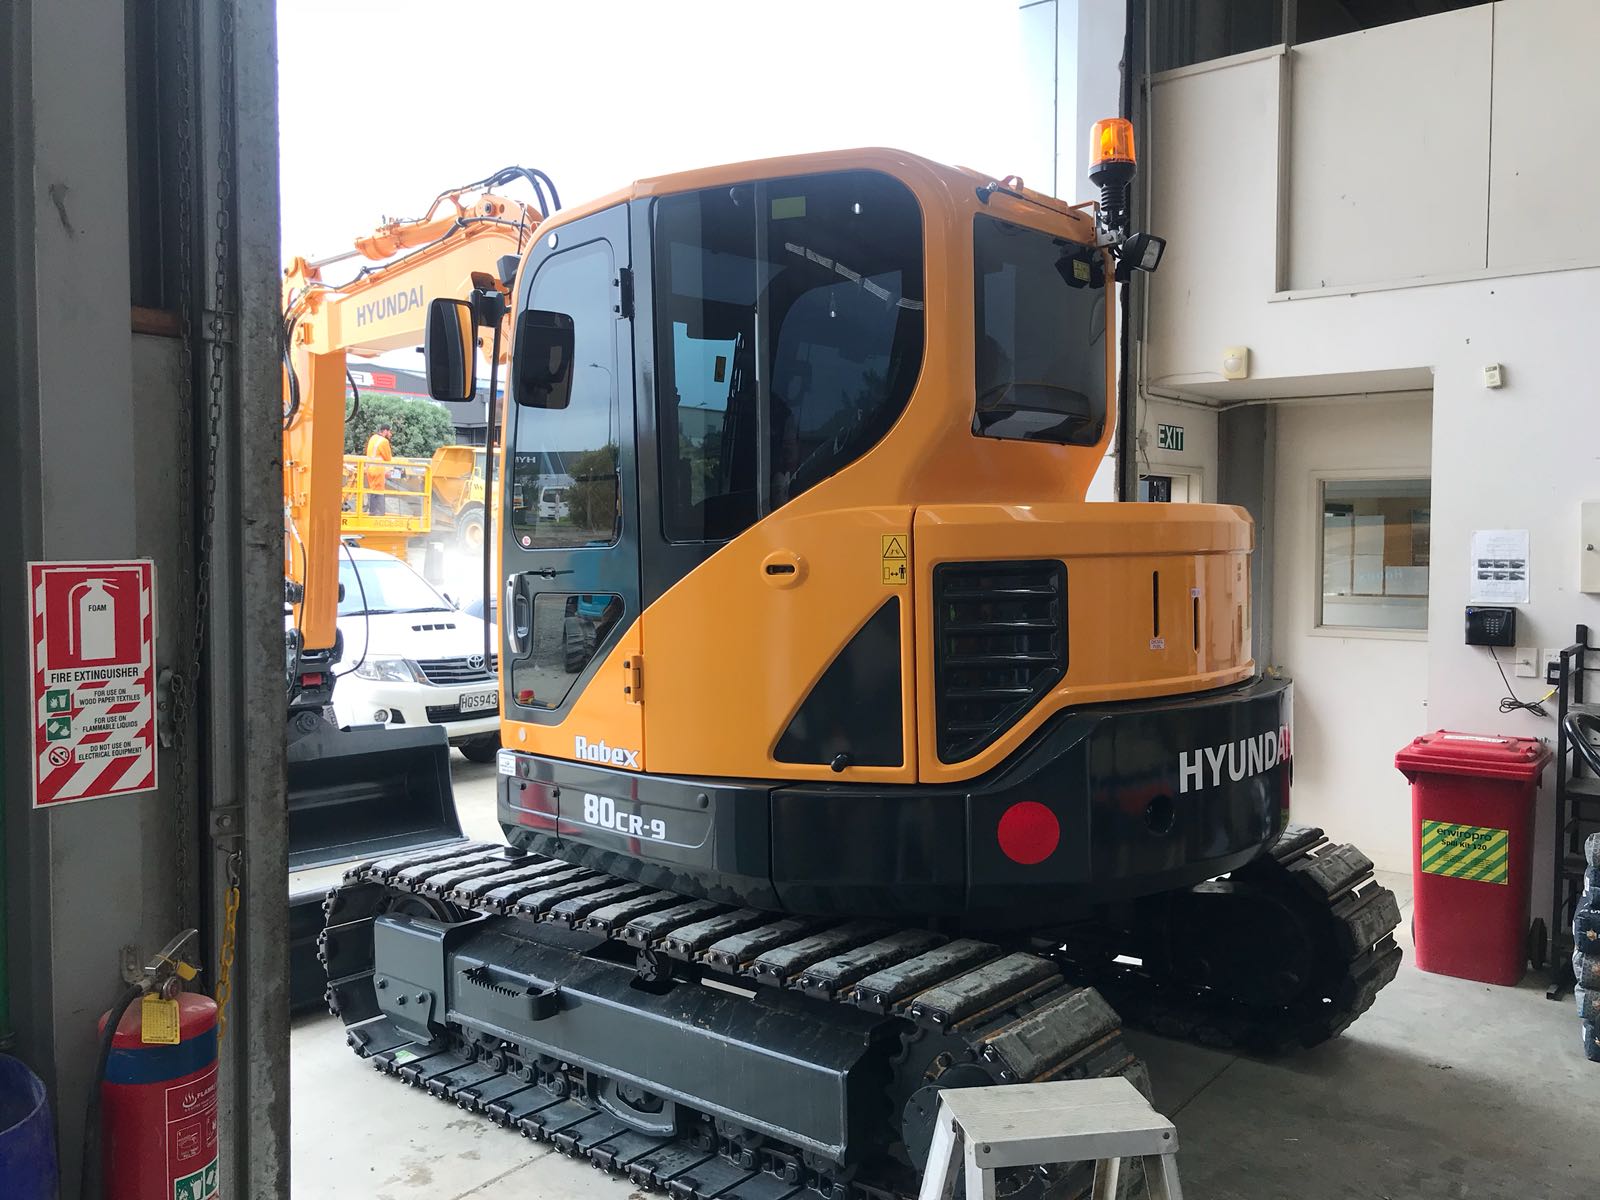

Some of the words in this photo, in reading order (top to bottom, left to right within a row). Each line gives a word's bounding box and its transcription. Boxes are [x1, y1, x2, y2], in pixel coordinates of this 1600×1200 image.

[356, 285, 424, 327] HYUNDAI
[1158, 425, 1184, 450] EXIT
[88, 604, 107, 612] FOAM
[51, 673, 72, 683] FIRE
[74, 667, 139, 681] EXTINGUISHER
[79, 698, 96, 706] WOOD
[98, 696, 115, 704] PAPER
[116, 694, 141, 702] TEXTILES
[461, 693, 498, 709] HQS943
[82, 723, 115, 733] FLAMMABLE
[116, 721, 138, 729] LIQUIDS
[78, 751, 111, 761] ELECTRICAL
[111, 747, 142, 757] EQUIPMENT
[575, 735, 641, 769] Robex
[1179, 723, 1289, 794] HYUNDAI
[584, 793, 666, 840] 80CR-9
[1437, 827, 1492, 841] enviropro
[1441, 839, 1458, 847] Spill
[1459, 841, 1471, 849] Kit
